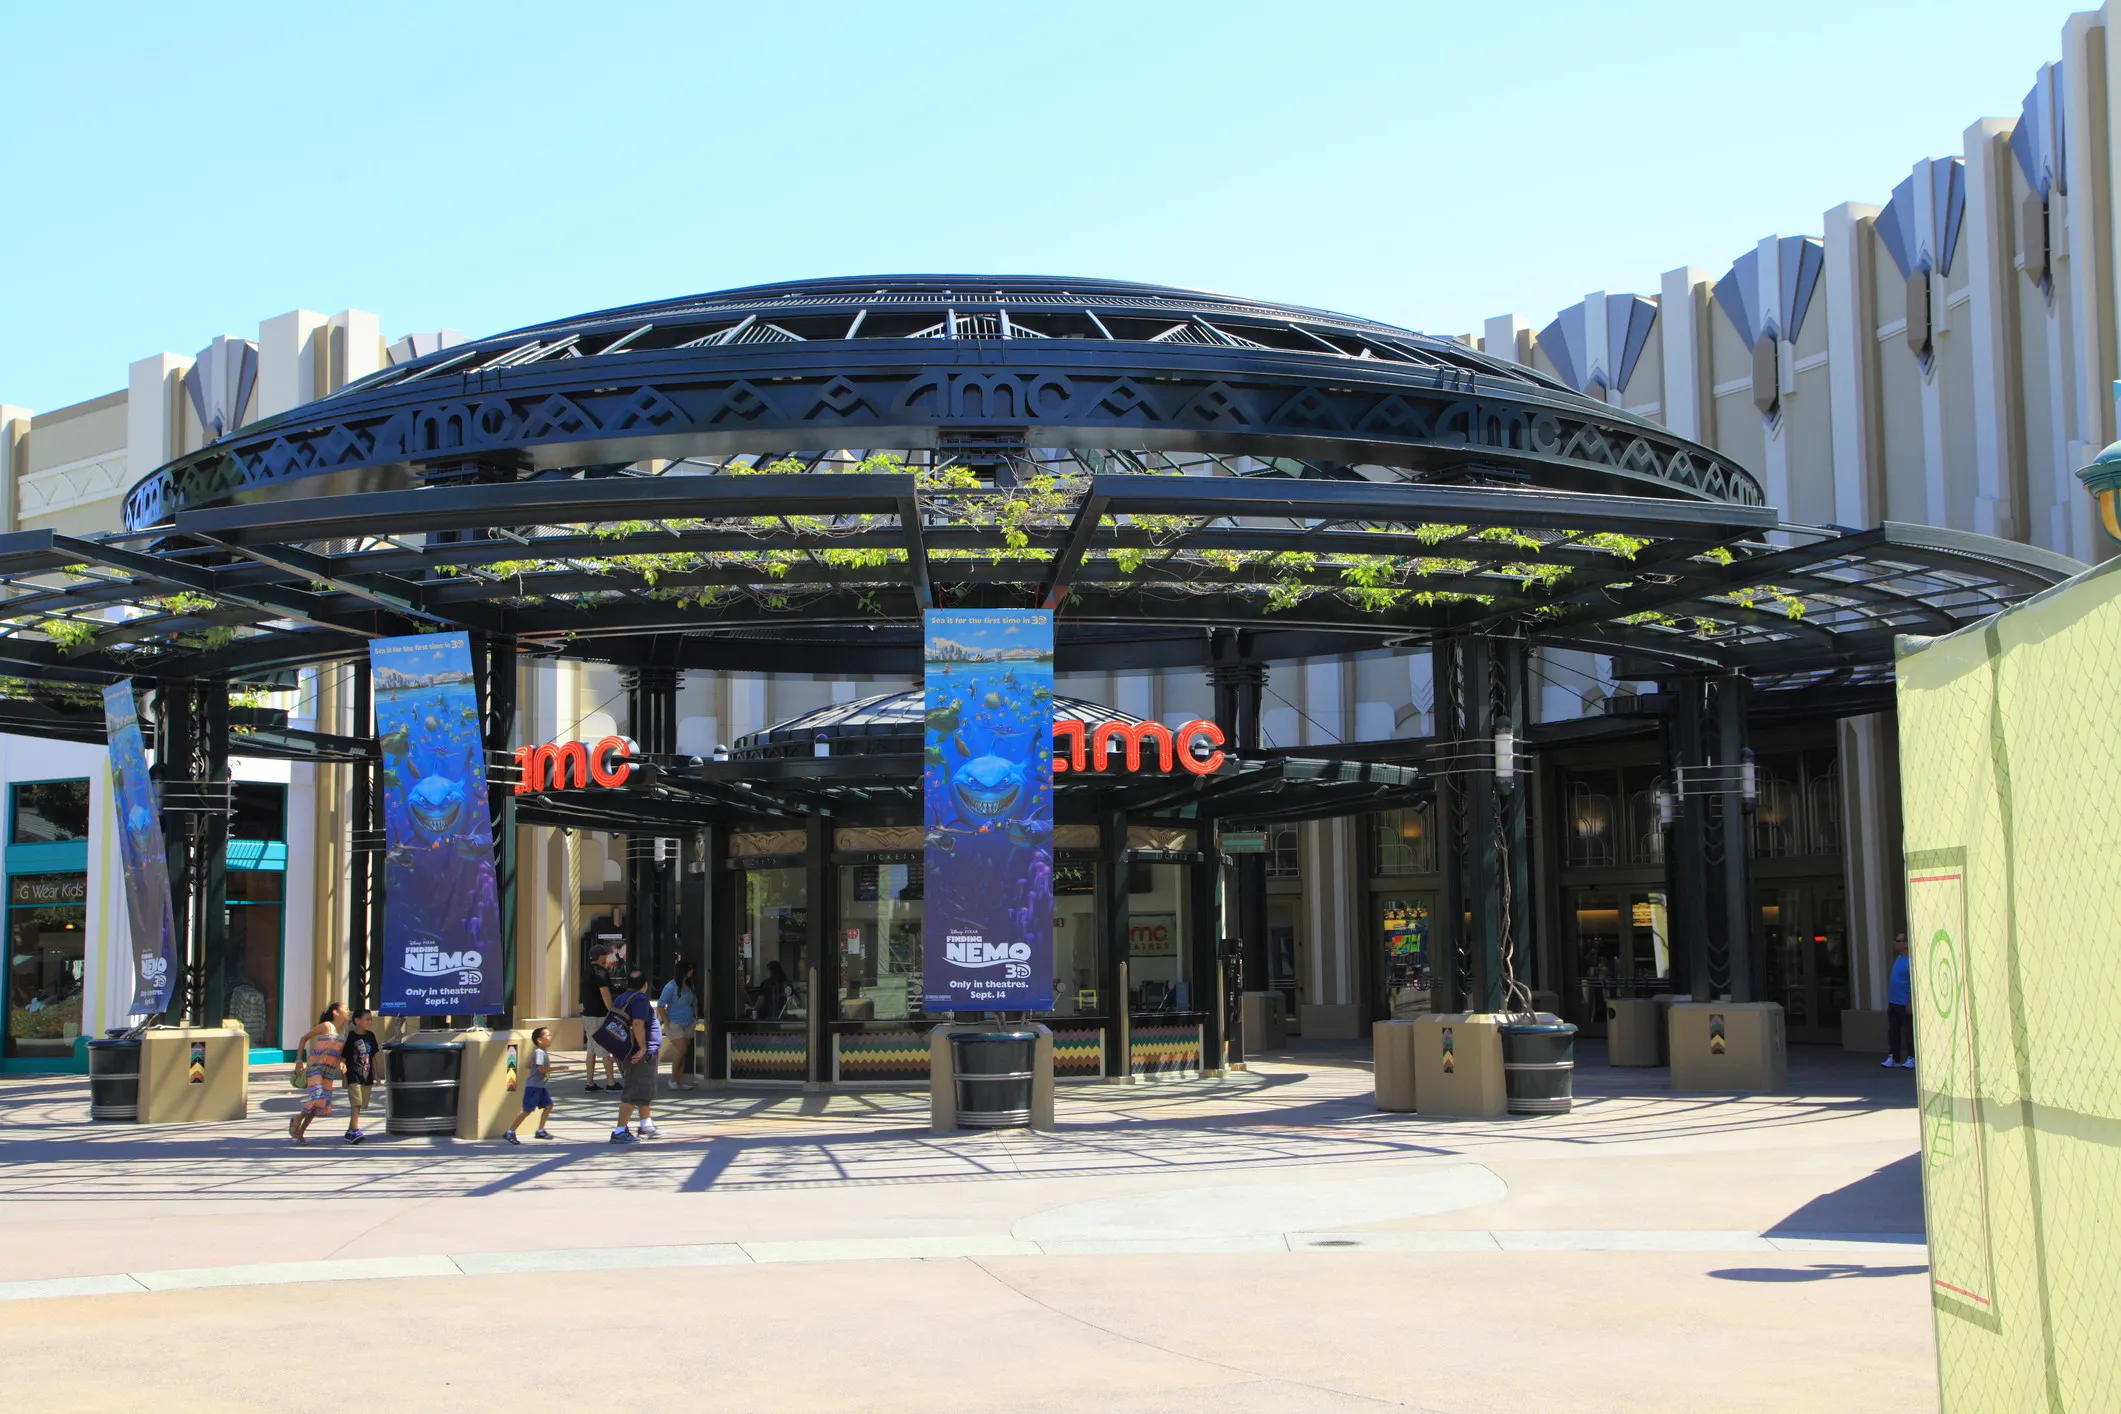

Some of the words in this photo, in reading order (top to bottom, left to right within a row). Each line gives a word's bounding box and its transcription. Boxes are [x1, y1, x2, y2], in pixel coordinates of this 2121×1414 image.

[890, 367, 1075, 420] amc
[1434, 400, 1562, 456] amc
[955, 616, 967, 624] for
[969, 616, 981, 624] the
[984, 616, 1000, 624] first
[1002, 616, 1020, 624] time
[1022, 616, 1030, 624] in
[866, 853, 916, 861] TICKETS
[20, 885, 29, 899] G
[32, 884, 59, 898] Wear
[62, 881, 84, 897] Kids
[1129, 925, 1168, 942] mc
[946, 942, 1031, 962] NEMO
[404, 950, 482, 971] NEMO
[458, 971, 483, 985] 3D
[1005, 963, 1031, 979] 3D
[405, 988, 427, 997] Only
[429, 987, 438, 995] in
[440, 987, 481, 995] theatres.
[949, 980, 972, 990] Only
[974, 980, 983, 988] in
[985, 980, 1029, 988] theatres.
[425, 997, 448, 1006] Sept.
[450, 997, 459, 1005] 14
[970, 990, 995, 1000] Sept.
[996, 990, 1006, 999] 14
